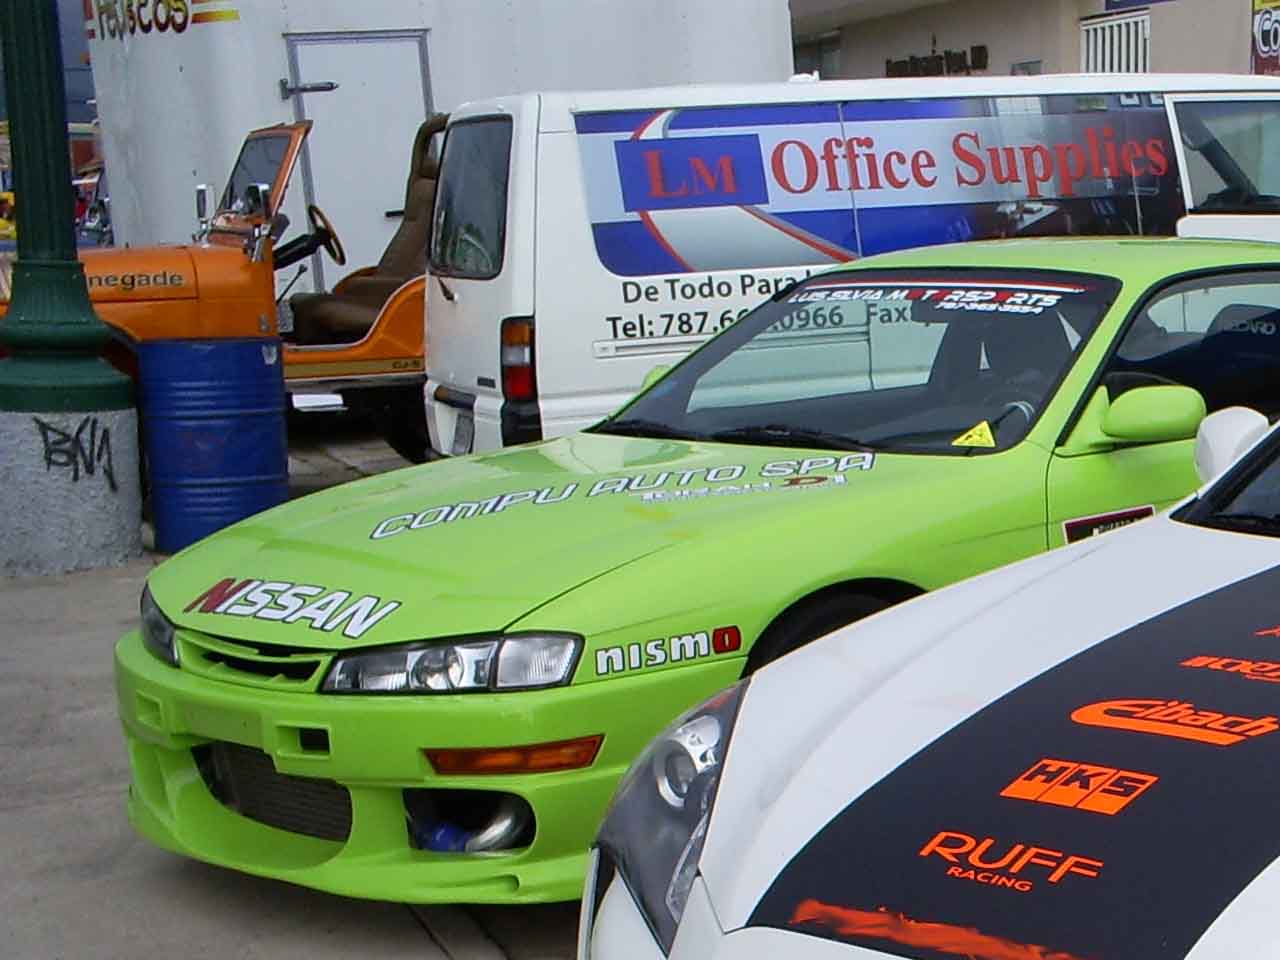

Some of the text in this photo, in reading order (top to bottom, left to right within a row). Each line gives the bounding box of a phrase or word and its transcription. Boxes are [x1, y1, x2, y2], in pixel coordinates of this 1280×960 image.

[771, 136, 938, 194] Office
[952, 127, 1169, 198] Supplies
[88, 271, 183, 291] negade
[622, 281, 659, 304] De
[664, 275, 732, 301] Todo
[606, 313, 655, 339] Tel:
[370, 483, 577, 540] COMPU
[588, 464, 744, 498] AUTO
[760, 452, 876, 478] SPA
[184, 577, 401, 640] NISSAN
[596, 625, 742, 675] nismo
[1071, 699, 1279, 746] Eibach
[1012, 759, 1153, 804] HKS
[919, 831, 1104, 884] RUFF
[947, 866, 1033, 893] RACING
